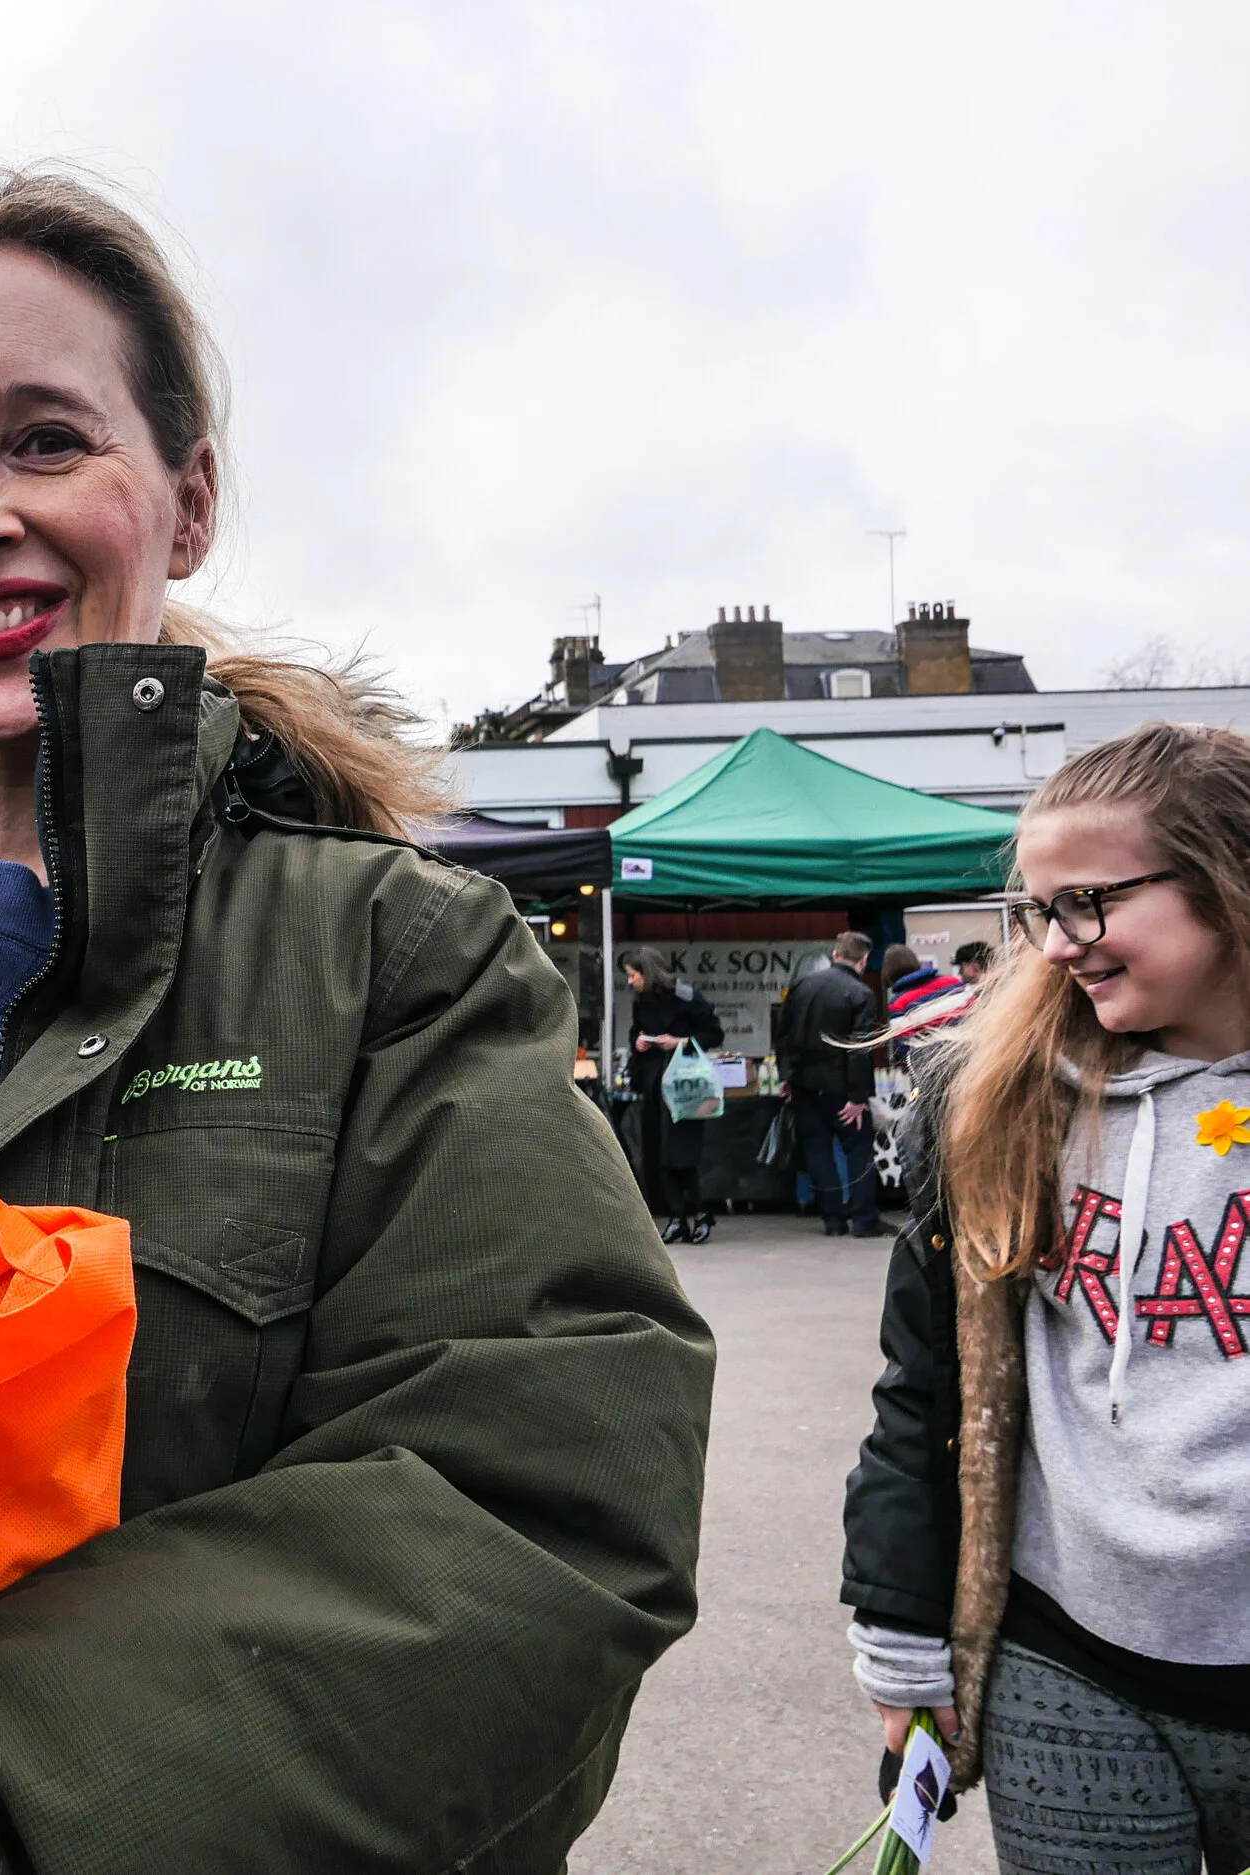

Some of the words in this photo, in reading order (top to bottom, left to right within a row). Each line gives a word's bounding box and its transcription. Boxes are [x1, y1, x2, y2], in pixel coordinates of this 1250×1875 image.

[697, 949, 718, 974] &
[728, 949, 792, 975] SON
[121, 1055, 262, 1105] Bergans
[190, 1080, 207, 1092] OF
[210, 1078, 262, 1091] NORWAY
